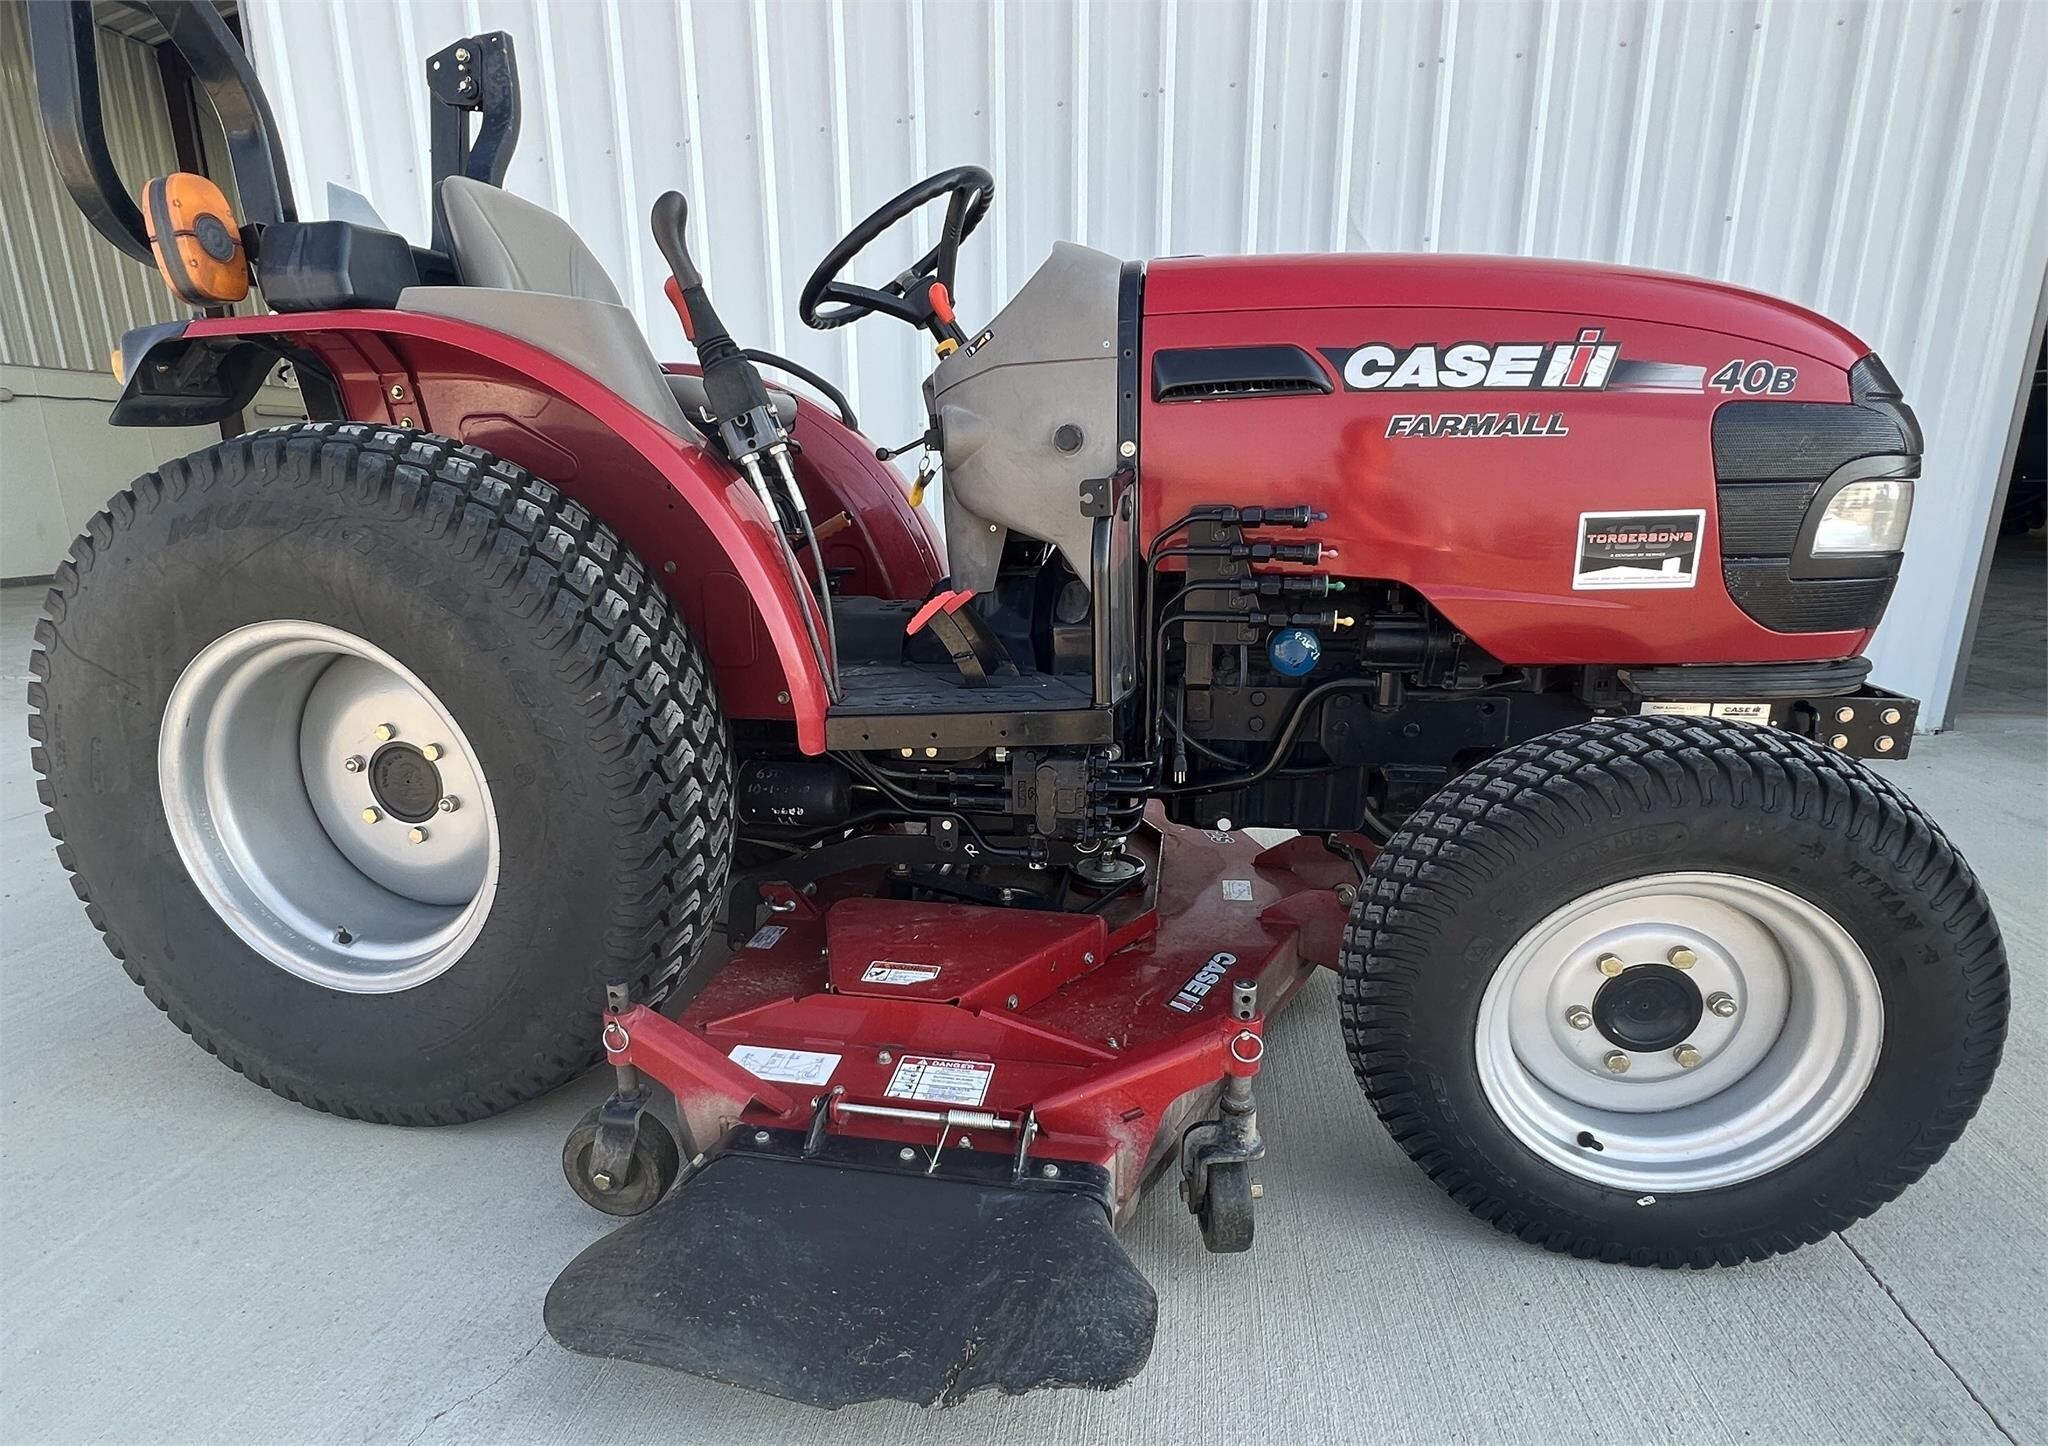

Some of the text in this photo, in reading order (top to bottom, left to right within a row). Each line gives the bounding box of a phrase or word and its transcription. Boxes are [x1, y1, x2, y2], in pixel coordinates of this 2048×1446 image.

[1343, 344, 1543, 389] CASE
[1708, 359, 1798, 395] 40B
[1385, 412, 1570, 438] FARMALL
[1587, 532, 1693, 544] TORGERSON'S
[1184, 952, 1237, 997] CASE
[931, 1060, 975, 1071] DANGER
